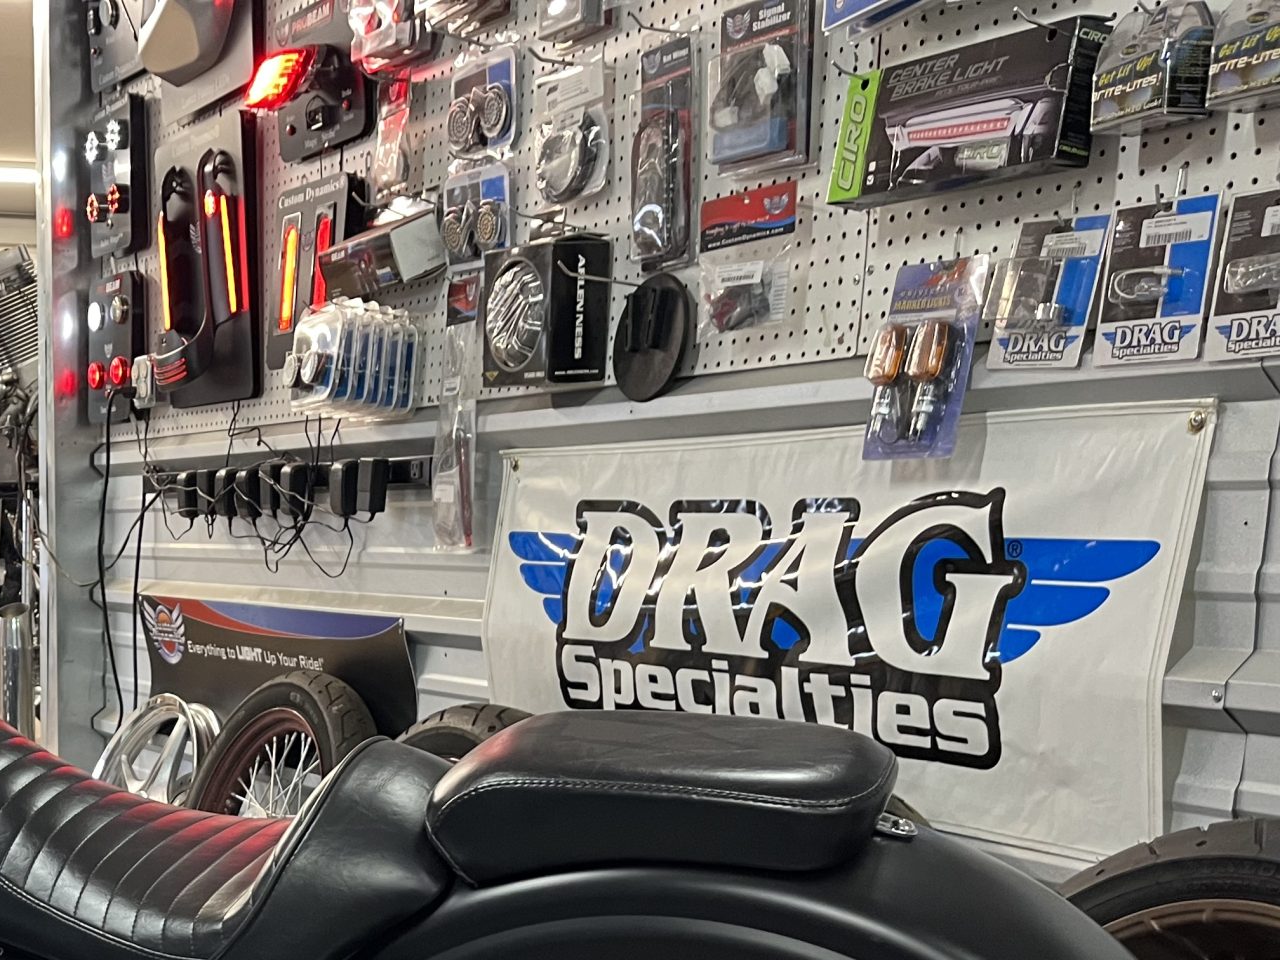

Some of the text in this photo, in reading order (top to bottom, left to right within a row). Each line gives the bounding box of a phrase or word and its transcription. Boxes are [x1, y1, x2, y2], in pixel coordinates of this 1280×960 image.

[752, 11, 791, 32] Stabilizer
[758, 2, 785, 20] Signal
[1079, 27, 1109, 43] CIRO
[1219, 41, 1240, 58] Get
[888, 53, 960, 84] CENTER
[891, 55, 1010, 98] BRAKE LIGHT
[1099, 70, 1116, 87] Get
[1136, 53, 1157, 71] Up!
[837, 94, 868, 192] CIRO
[278, 192, 305, 209] Custom
[573, 314, 585, 360] NESS
[1115, 319, 1182, 349] DRAG
[1231, 315, 1280, 341] DRA
[1007, 330, 1068, 355] DRAG
[1111, 342, 1180, 358] Specialties
[1227, 335, 1280, 352] Specialt
[1004, 352, 1063, 363] Specialties
[561, 492, 1020, 682] DRAG
[186, 639, 226, 660] Everything
[226, 646, 236, 659] to
[235, 644, 263, 663] LIGHT
[263, 650, 277, 667] Up
[276, 651, 298, 668] Your
